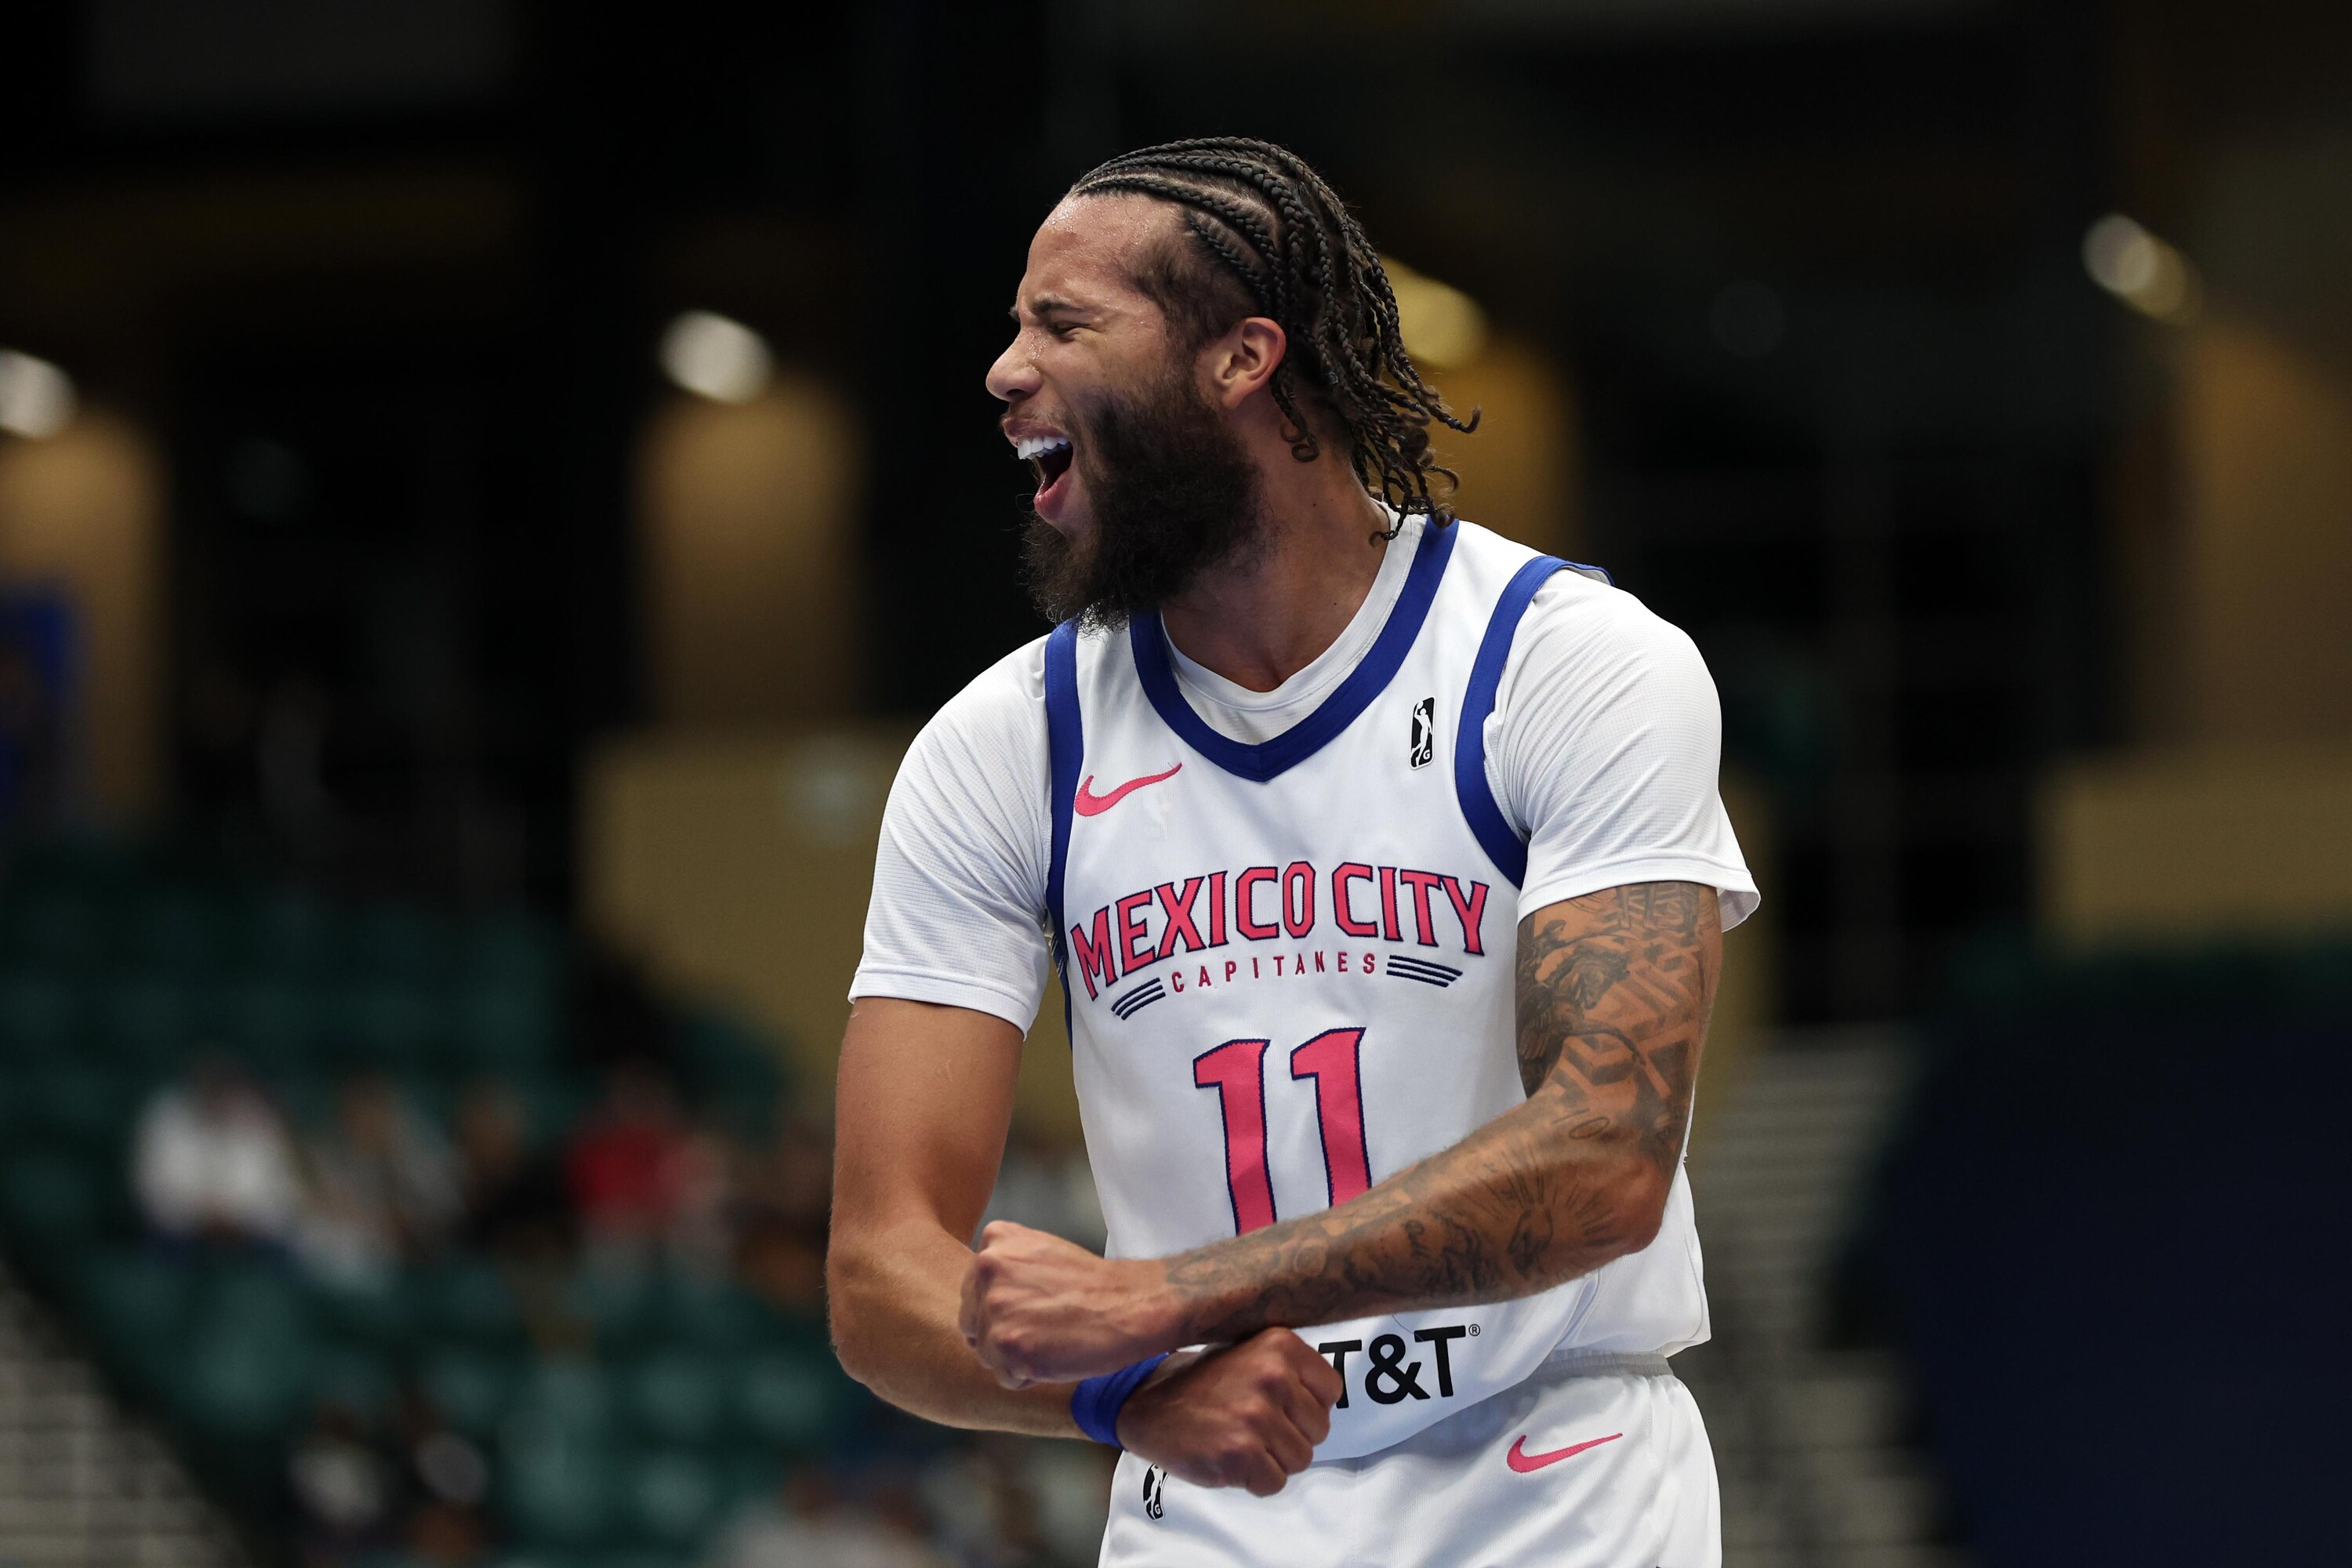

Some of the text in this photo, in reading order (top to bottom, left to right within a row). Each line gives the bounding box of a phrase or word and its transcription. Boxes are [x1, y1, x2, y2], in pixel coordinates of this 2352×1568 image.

[1070, 860, 1490, 1001] MEXICO CITY
[1171, 950, 1376, 993] CAPITANES
[1192, 1026, 1373, 1236] 11
